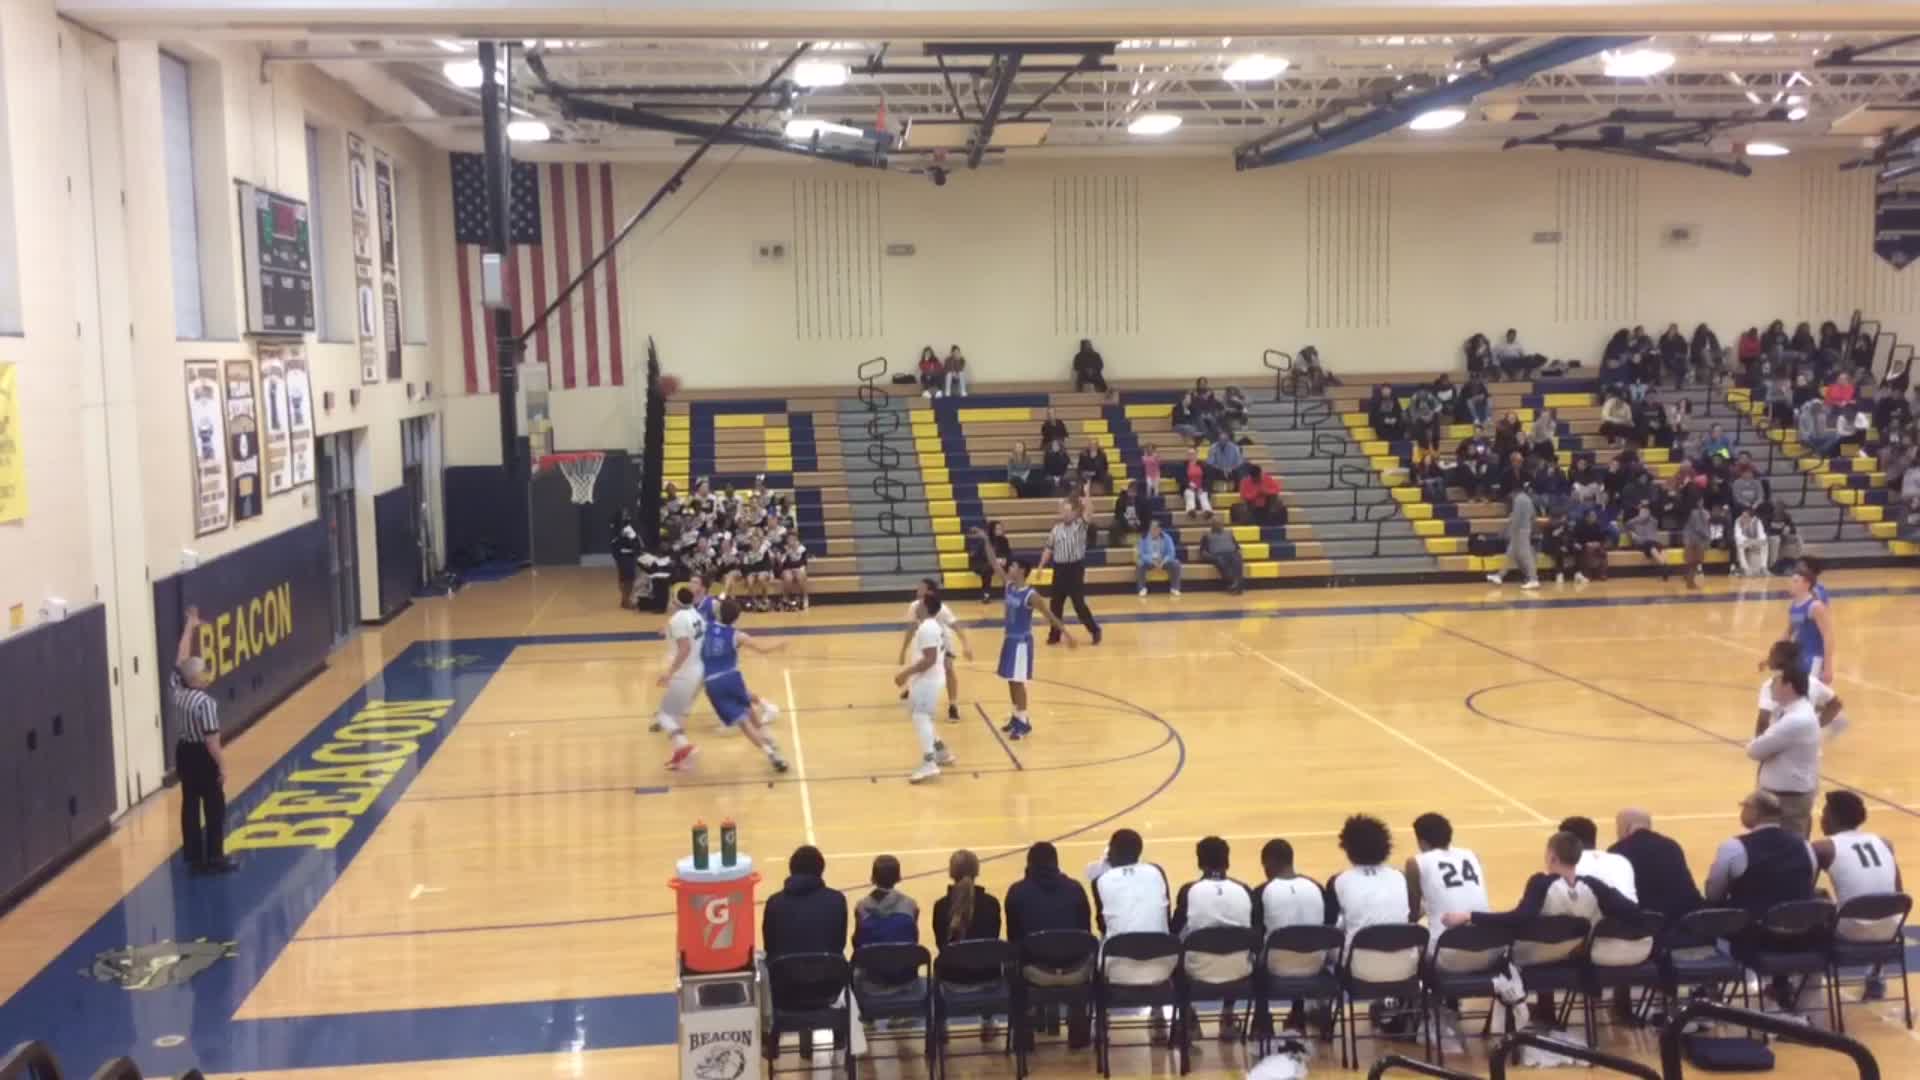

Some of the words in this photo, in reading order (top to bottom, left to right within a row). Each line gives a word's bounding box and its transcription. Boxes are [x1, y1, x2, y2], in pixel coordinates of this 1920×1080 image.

[199, 582, 292, 684] BEACON
[223, 699, 456, 855] BEACON
[1851, 843, 1882, 868] 11
[1438, 859, 1479, 888] 24
[705, 897, 729, 924] G
[689, 1030, 753, 1052] BEACON
